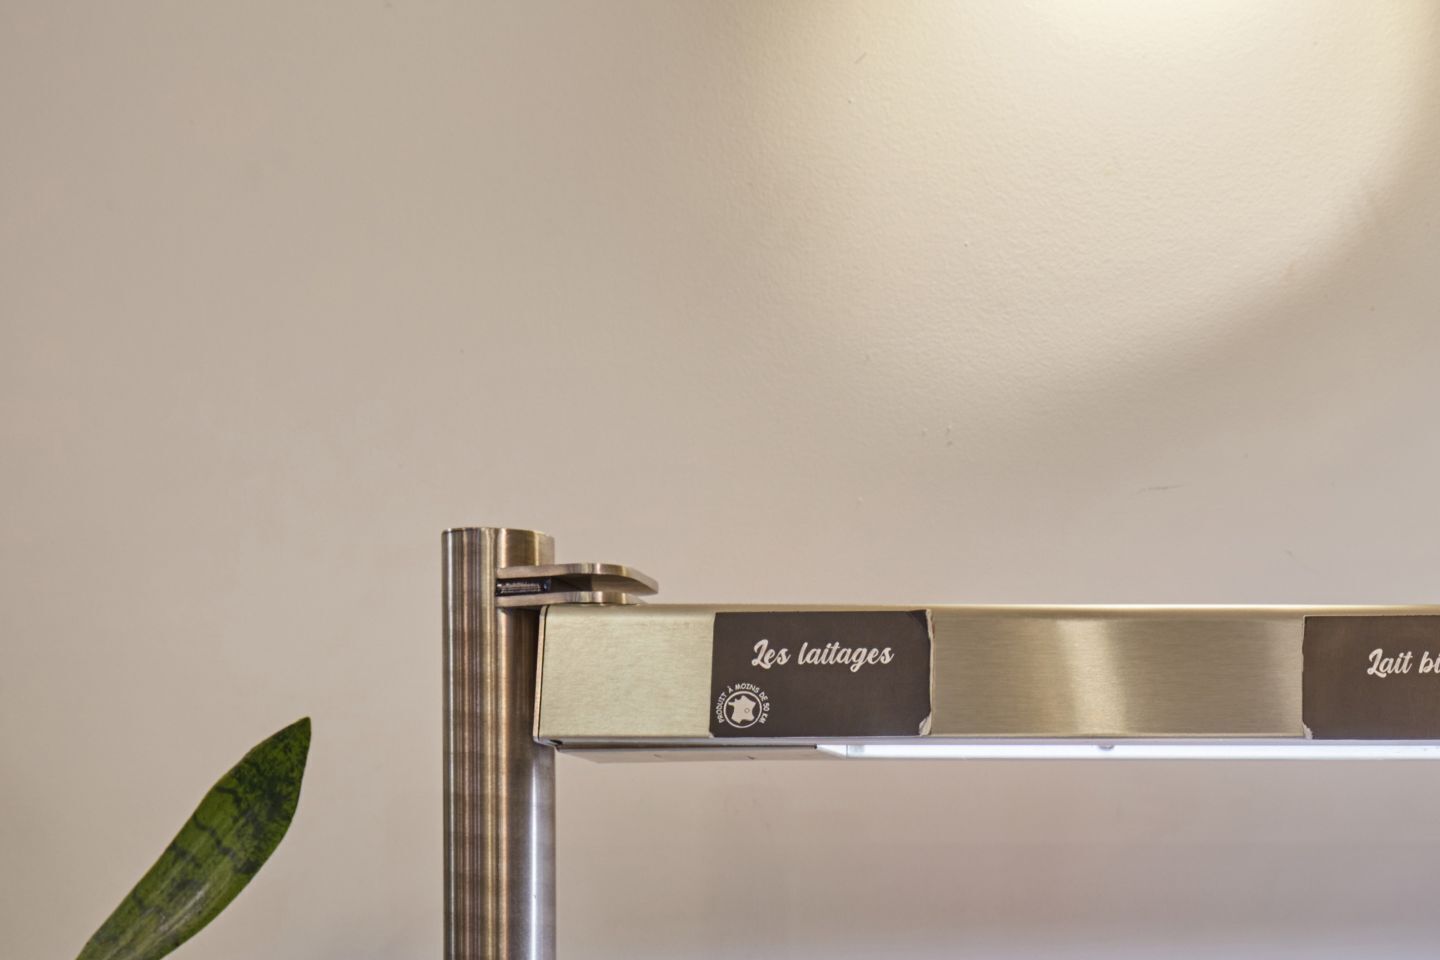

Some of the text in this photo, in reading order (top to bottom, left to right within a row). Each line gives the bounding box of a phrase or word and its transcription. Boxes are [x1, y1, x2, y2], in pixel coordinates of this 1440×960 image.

[751, 639, 894, 672] Les laitages
[1367, 648, 1413, 678] Lait
[715, 691, 727, 723] PRODUIT
[735, 683, 760, 693] MOINS
[759, 691, 768, 701] DE
